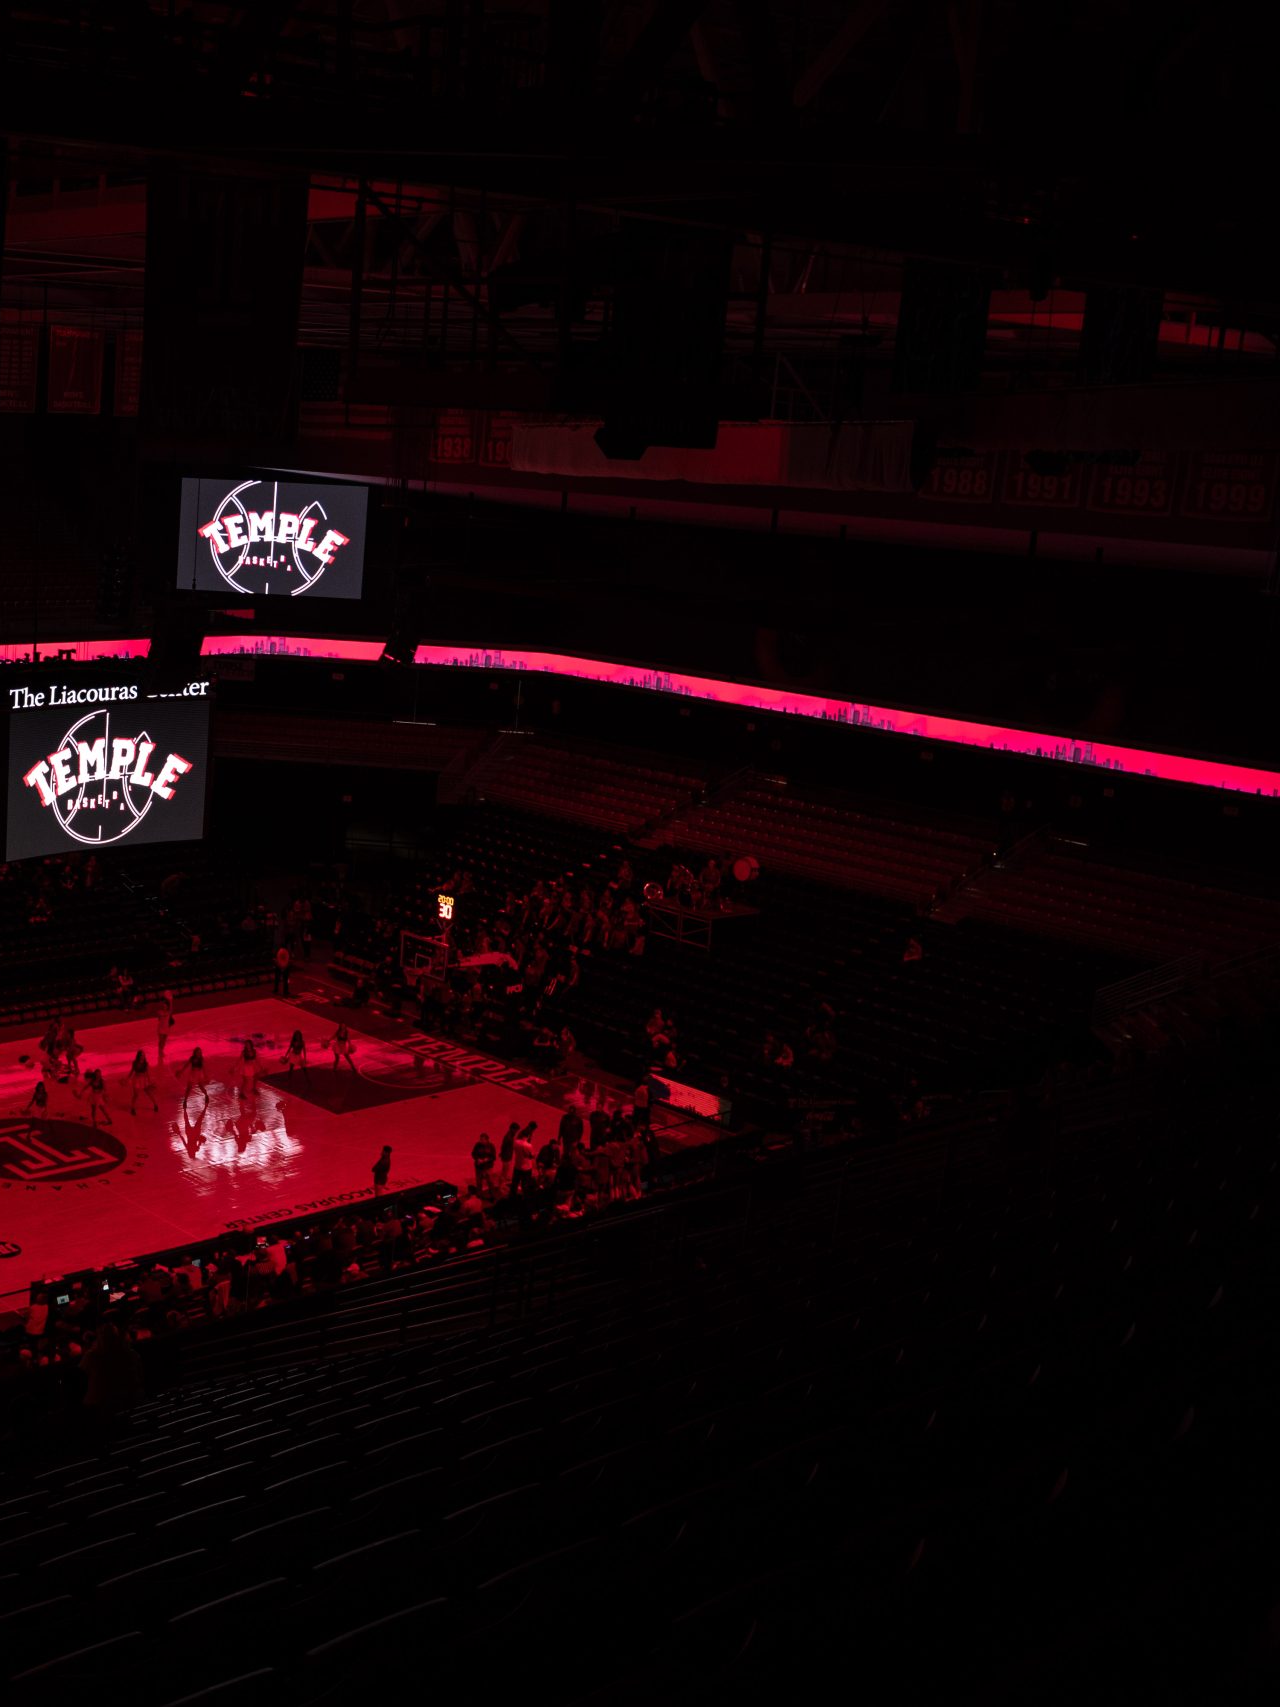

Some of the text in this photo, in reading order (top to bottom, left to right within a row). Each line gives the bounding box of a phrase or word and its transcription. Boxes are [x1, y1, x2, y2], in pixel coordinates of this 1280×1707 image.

[931, 466, 987, 496] 1988
[1012, 471, 1073, 499] 1991
[1102, 477, 1167, 508] 1993
[1197, 480, 1265, 512] 1999
[197, 510, 351, 565] TEMPLE
[9, 687, 45, 709] The
[49, 685, 138, 706] Liacouras
[23, 737, 193, 807] TEMPLE
[439, 903, 452, 920] 30
[390, 1033, 548, 1090] TEMPLE
[224, 1208, 295, 1231] CENTER
